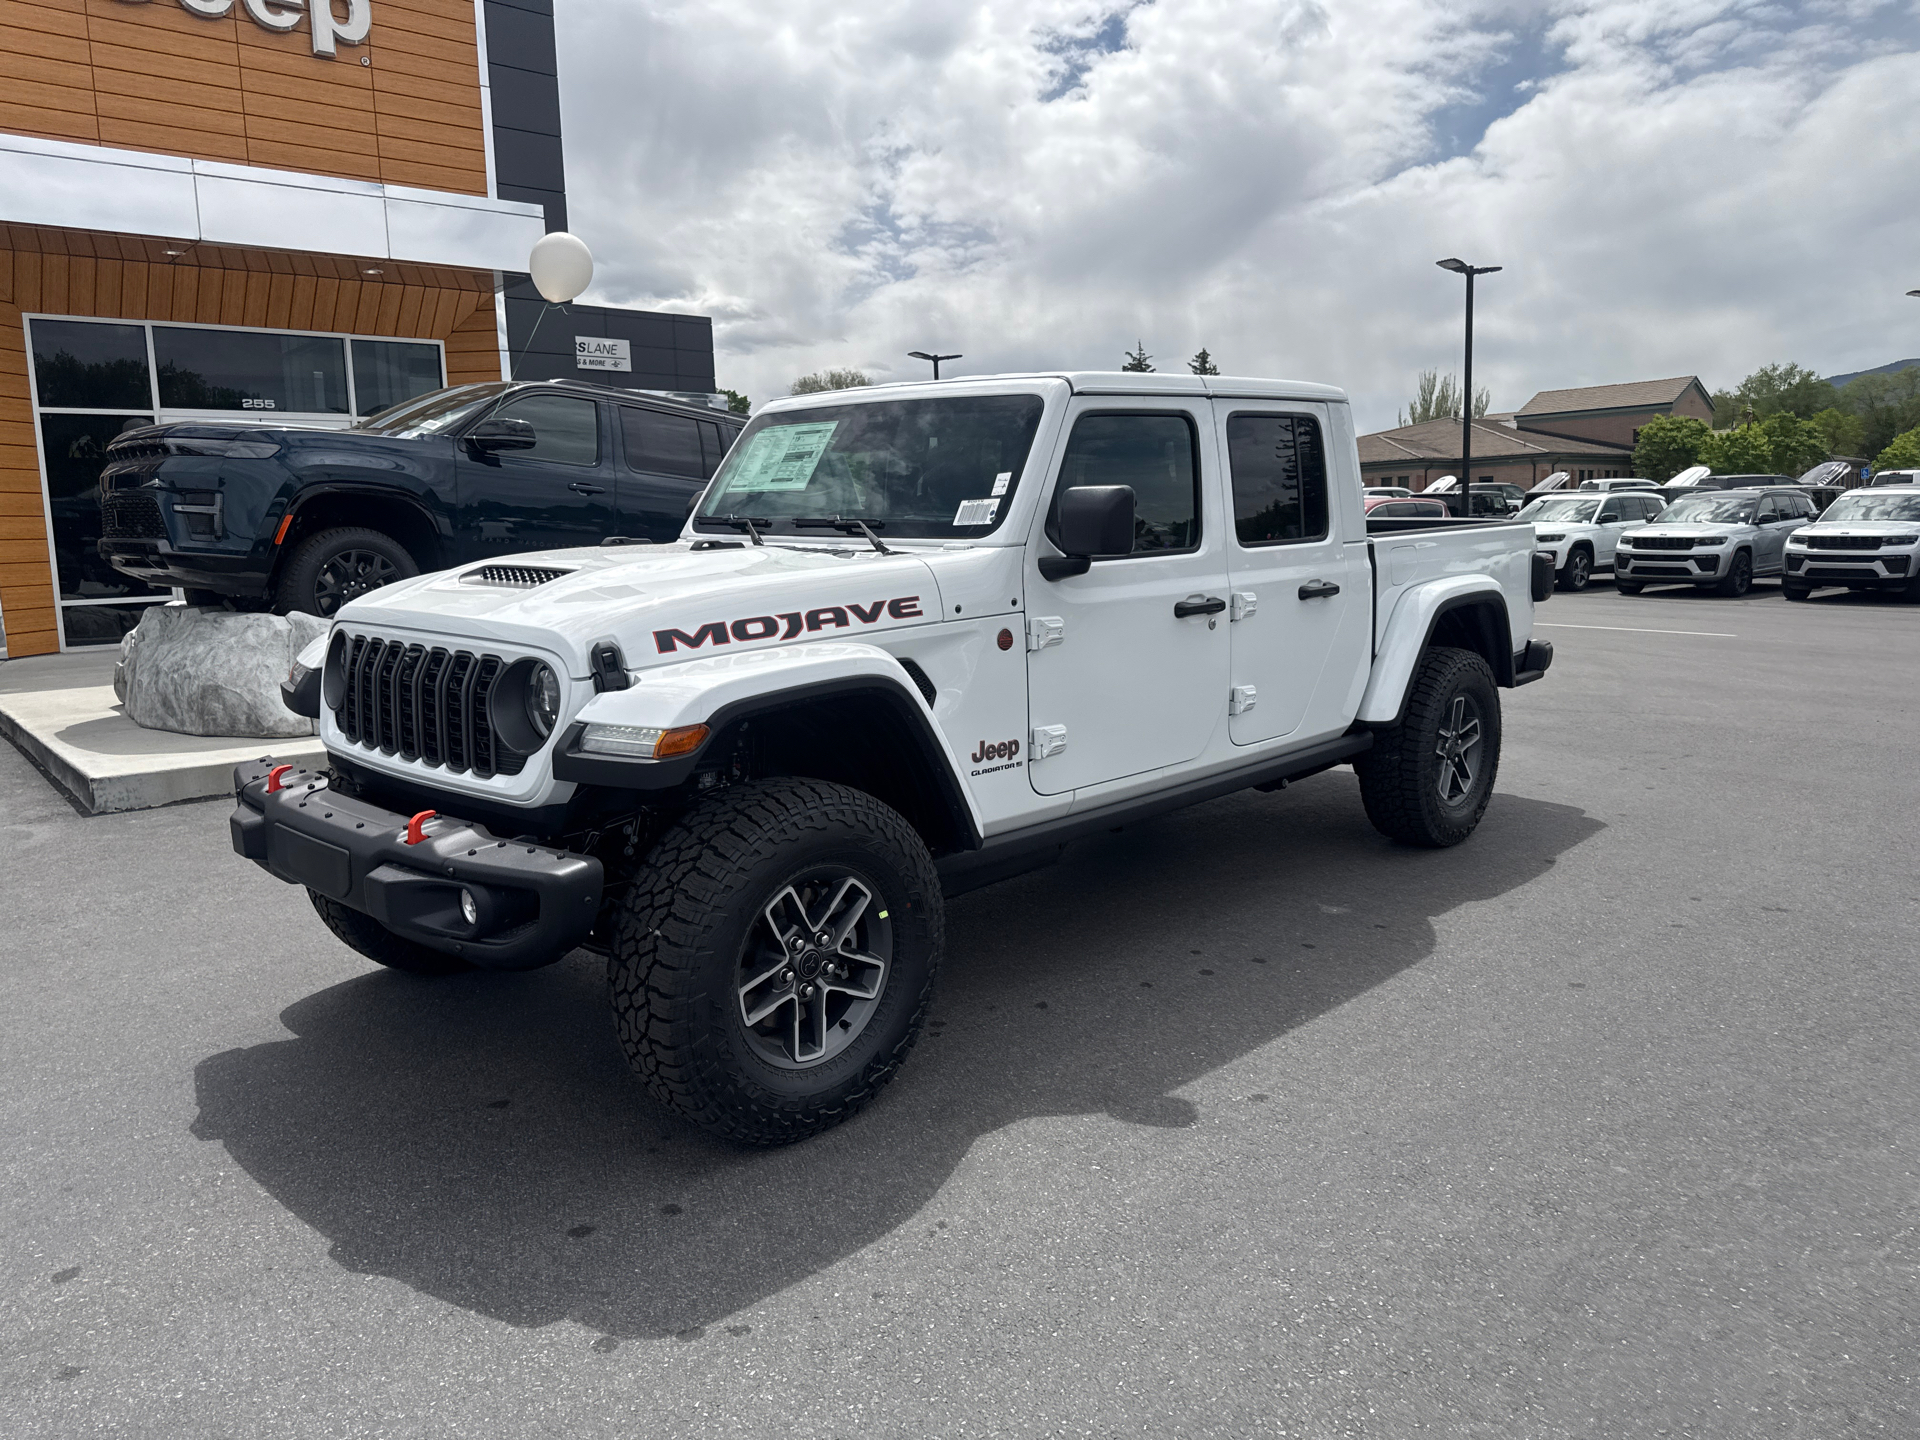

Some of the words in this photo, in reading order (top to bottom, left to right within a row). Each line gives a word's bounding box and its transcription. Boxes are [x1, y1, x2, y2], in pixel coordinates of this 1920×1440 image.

[588, 359, 606, 367] MORE
[242, 398, 276, 409] 255
[652, 595, 923, 654] MOJAVE
[971, 739, 1020, 763] Jeep
[971, 762, 1016, 777] GLADIATOR
